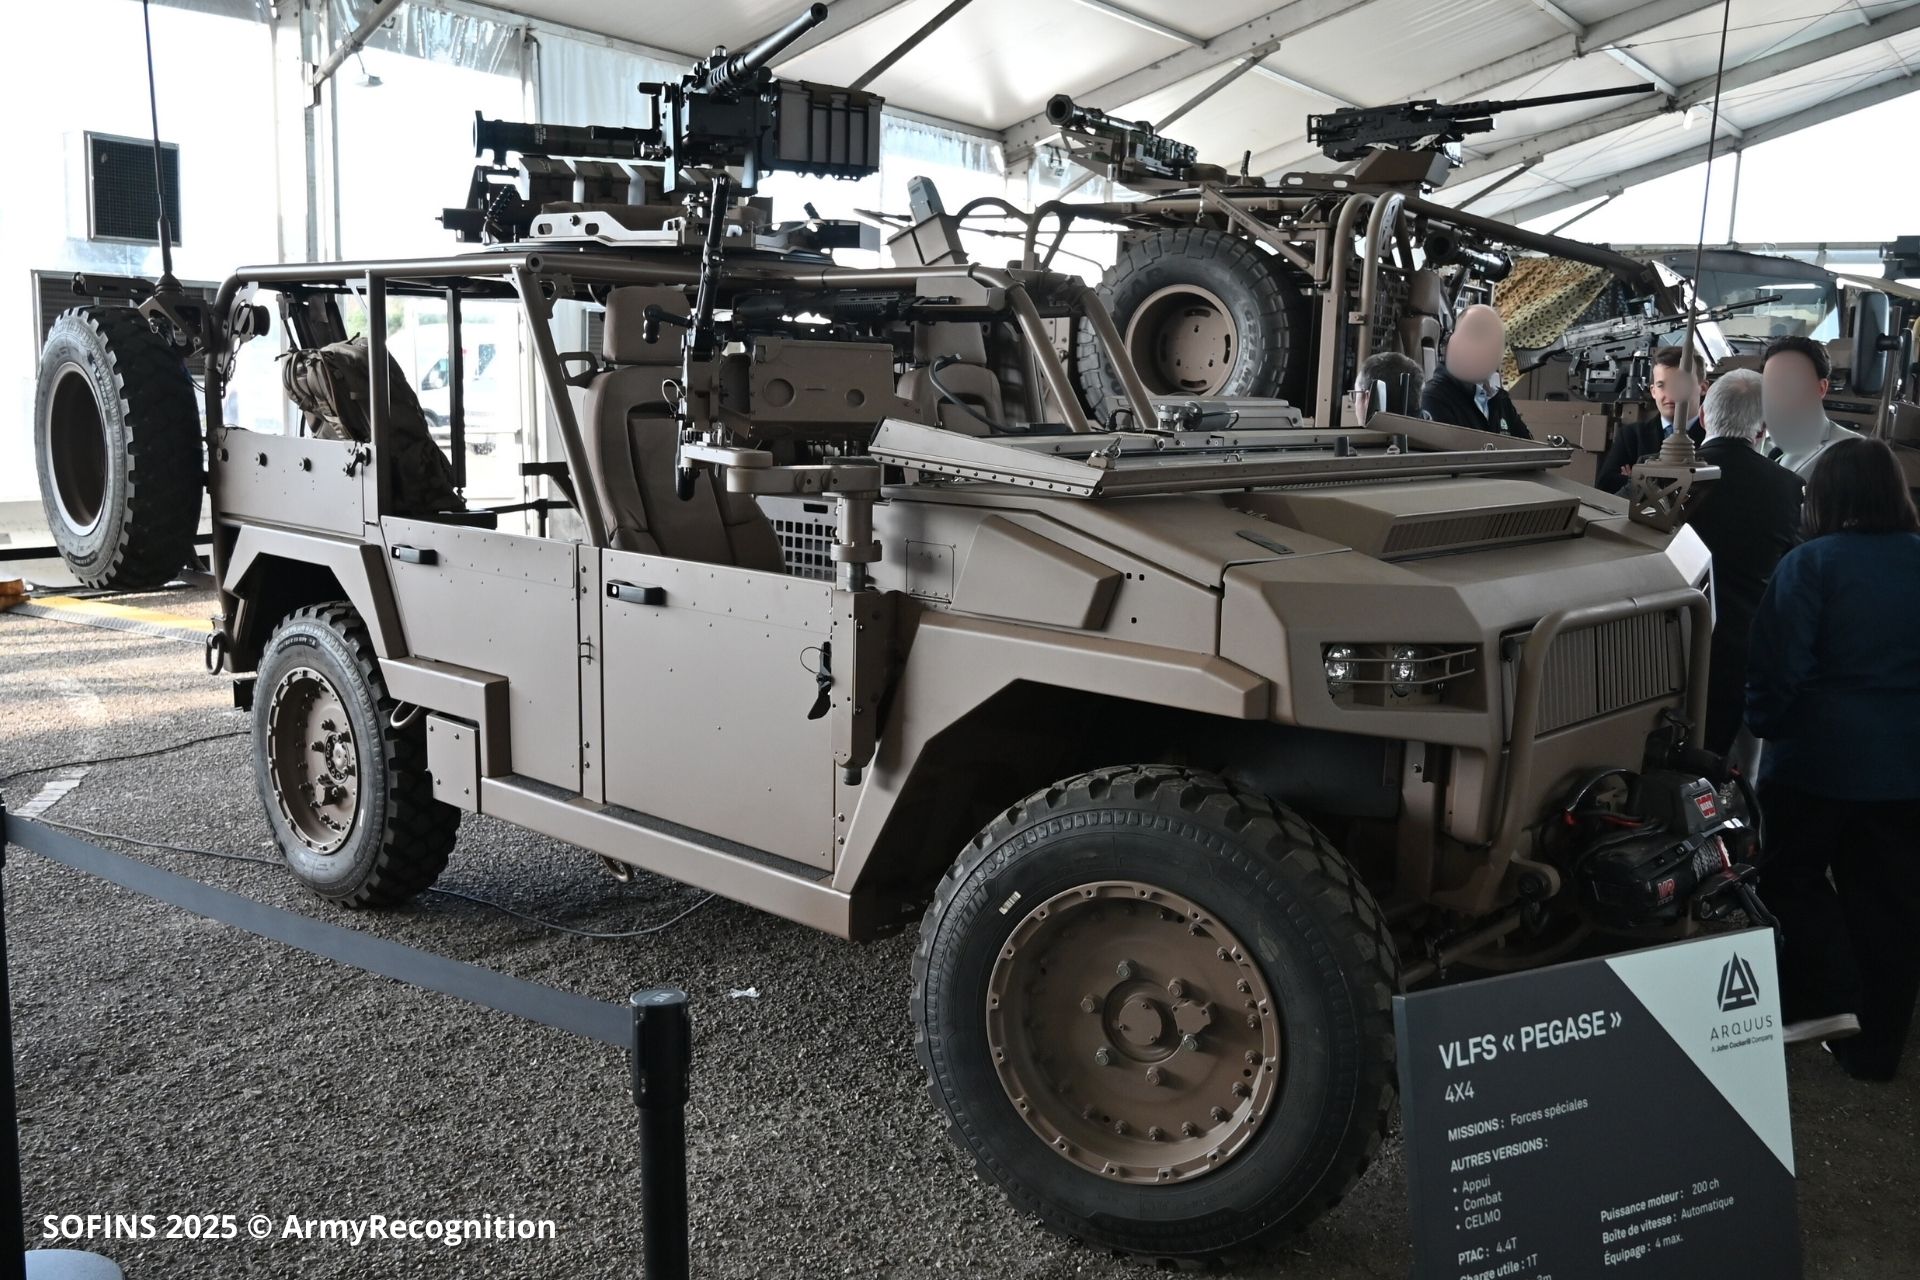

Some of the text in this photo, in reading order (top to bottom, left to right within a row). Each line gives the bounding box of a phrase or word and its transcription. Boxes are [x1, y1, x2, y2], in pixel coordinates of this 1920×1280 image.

[1710, 1014, 1773, 1041] ARQUUS
[1438, 1034, 1498, 1069] VLFS
[1520, 1010, 1607, 1052] PEGASE
[1444, 1080, 1475, 1103] 4X4
[1510, 1109, 1543, 1126] Forces
[1544, 1098, 1589, 1119] spéciales
[1450, 1151, 1492, 1173] AUTRES
[1461, 1173, 1491, 1194] Appui
[1463, 1191, 1502, 1211] Combat
[1600, 1200, 1646, 1222] Puissance
[1691, 1180, 1708, 1195] 200
[1708, 1178, 1720, 1190] ch
[1464, 1208, 1501, 1230] CELMO
[1602, 1228, 1627, 1244] Boîte
[1627, 1224, 1639, 1237] de
[1681, 1196, 1735, 1220] Automatique
[1496, 1236, 1518, 1254] 4.4T
[1655, 1238, 1661, 1248] 4
[1662, 1232, 1684, 1247] max.
[1526, 1253, 1538, 1268] 1T
